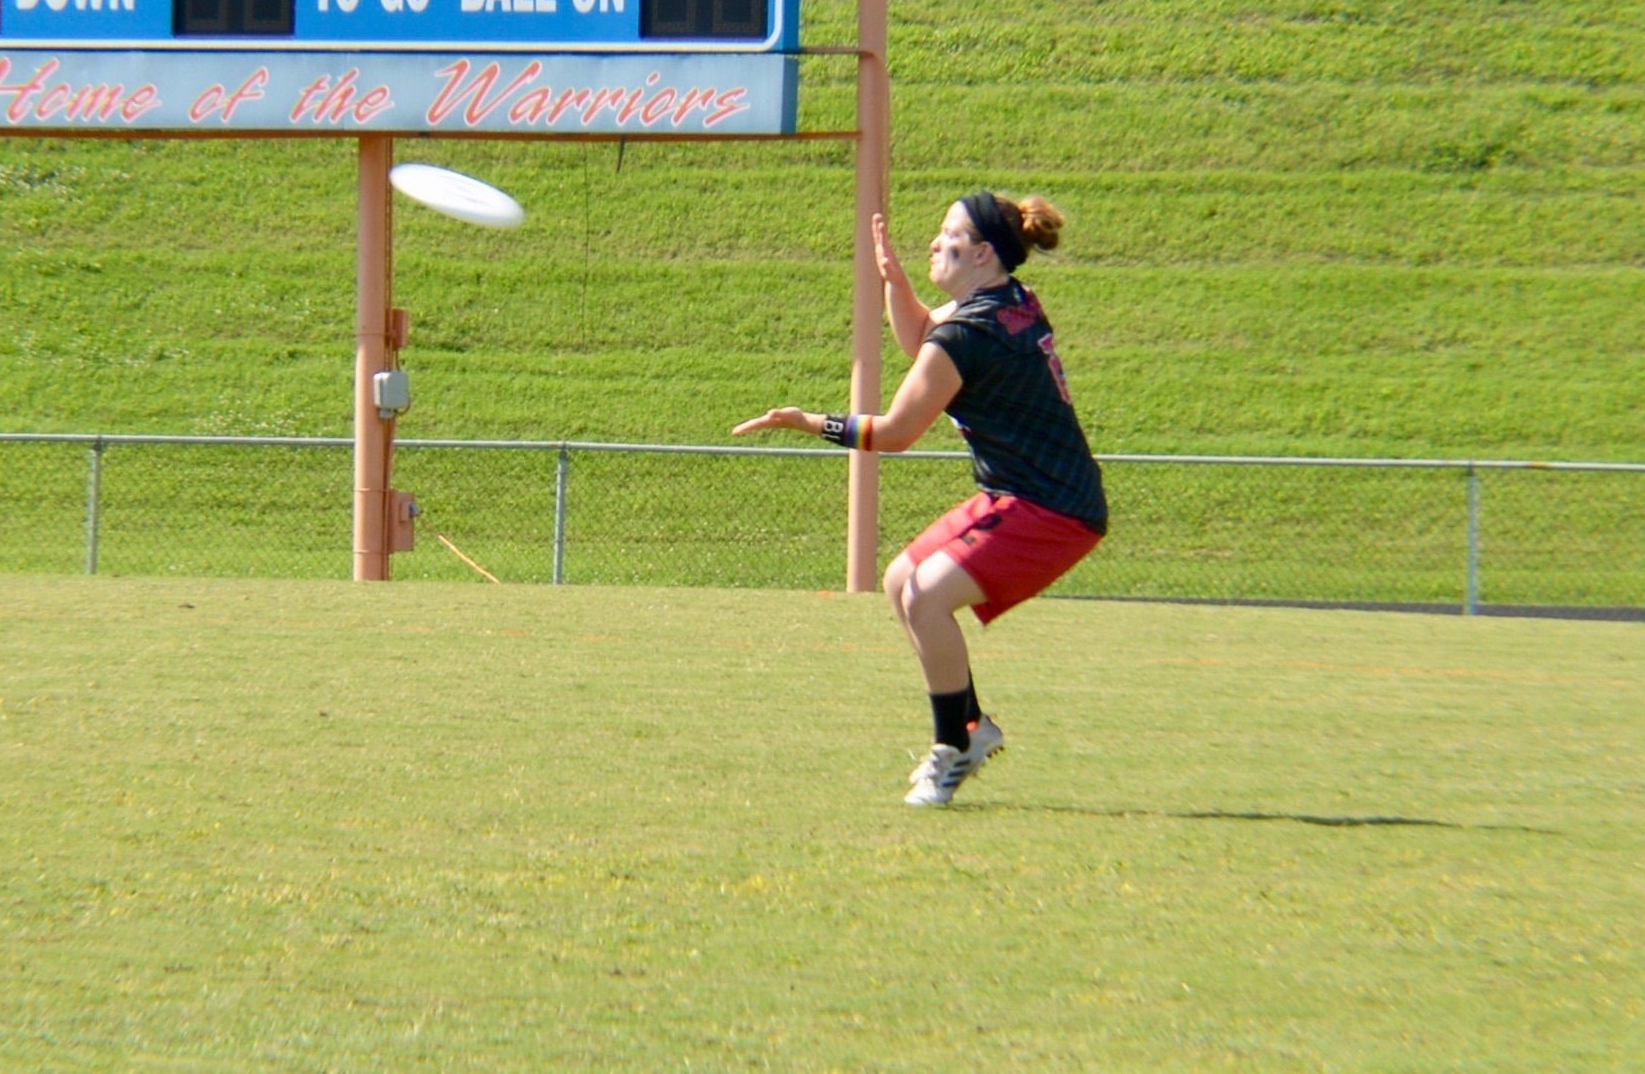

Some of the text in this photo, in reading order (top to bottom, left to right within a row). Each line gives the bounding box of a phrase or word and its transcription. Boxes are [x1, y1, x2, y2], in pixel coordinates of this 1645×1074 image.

[188, 67, 270, 123] of
[289, 68, 396, 123] the
[425, 59, 751, 128] Warriors
